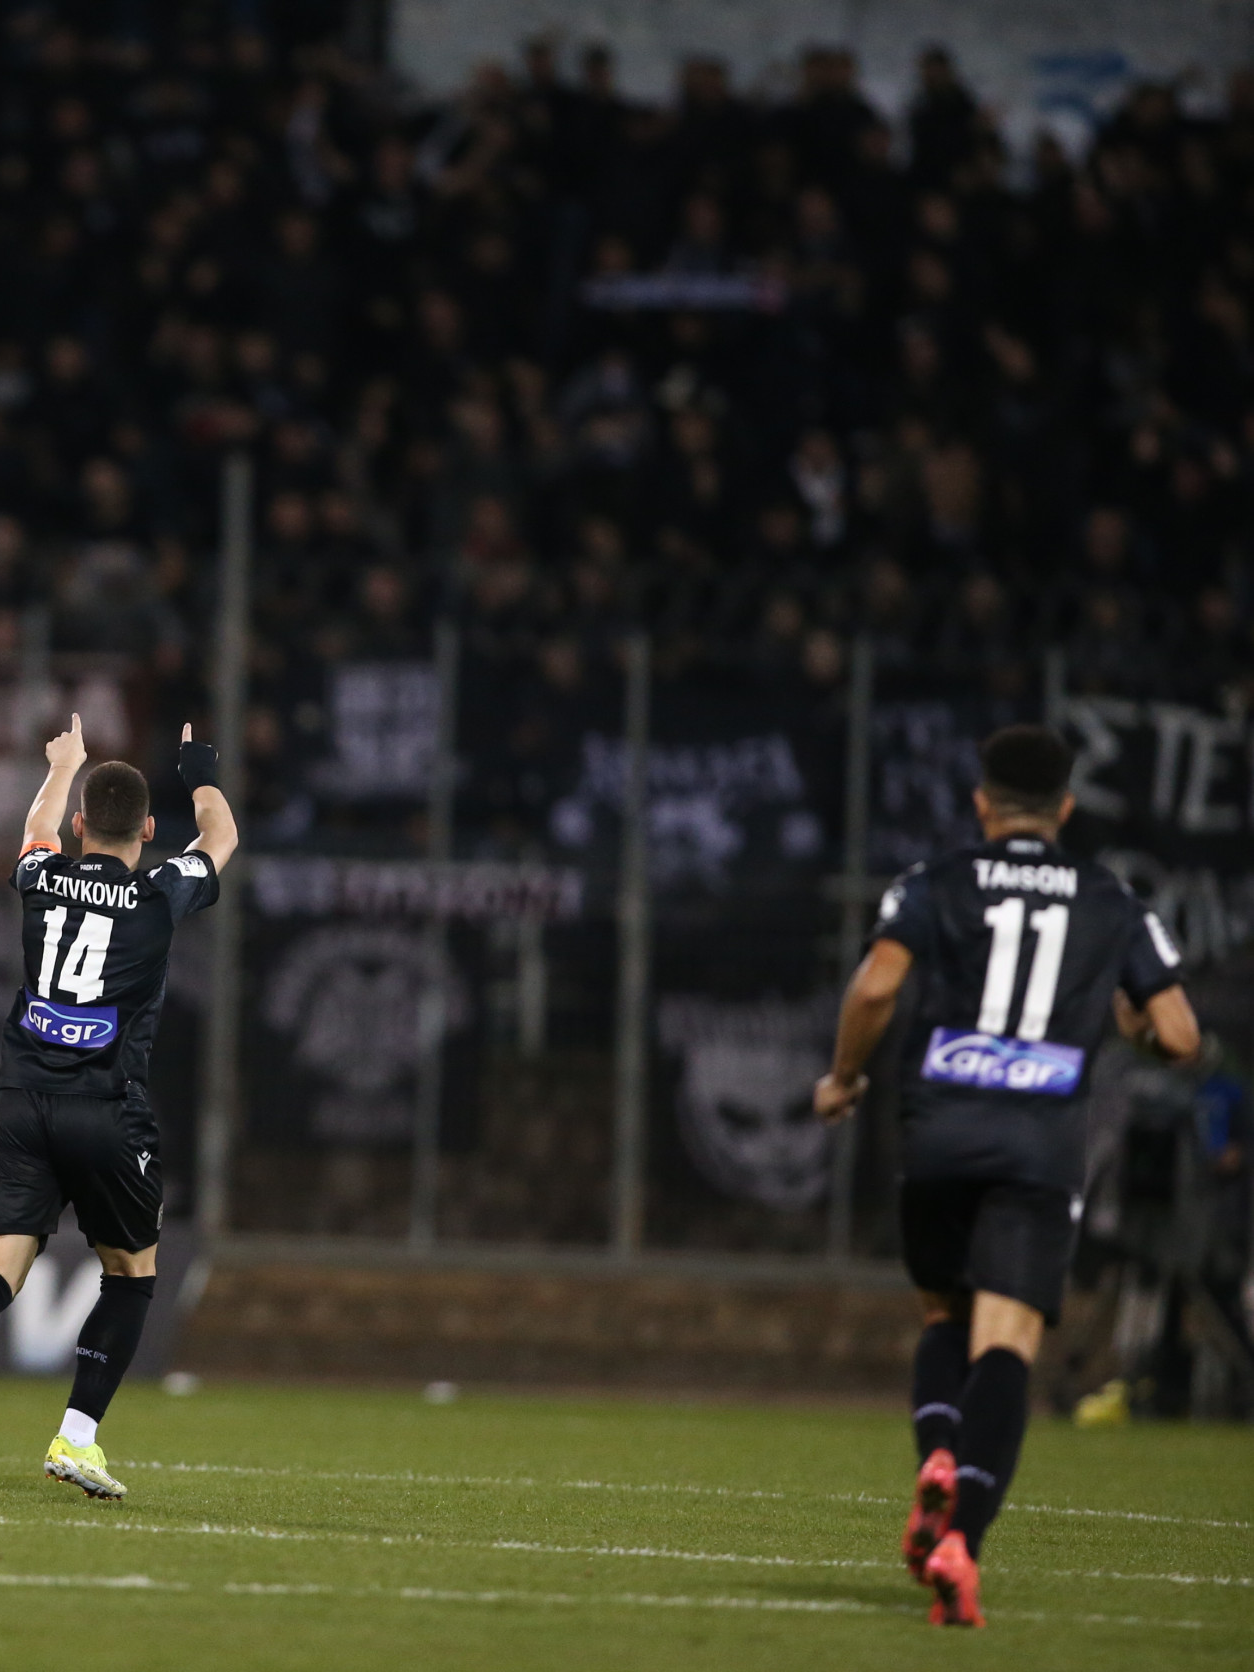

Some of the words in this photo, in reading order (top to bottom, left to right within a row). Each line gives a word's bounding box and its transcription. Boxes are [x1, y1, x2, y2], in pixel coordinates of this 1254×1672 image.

[36, 869, 139, 909] A.ZIVKOVIĆ
[972, 859, 1079, 898] TAISON
[37, 905, 115, 1005] 14
[975, 897, 1070, 1042] 11
